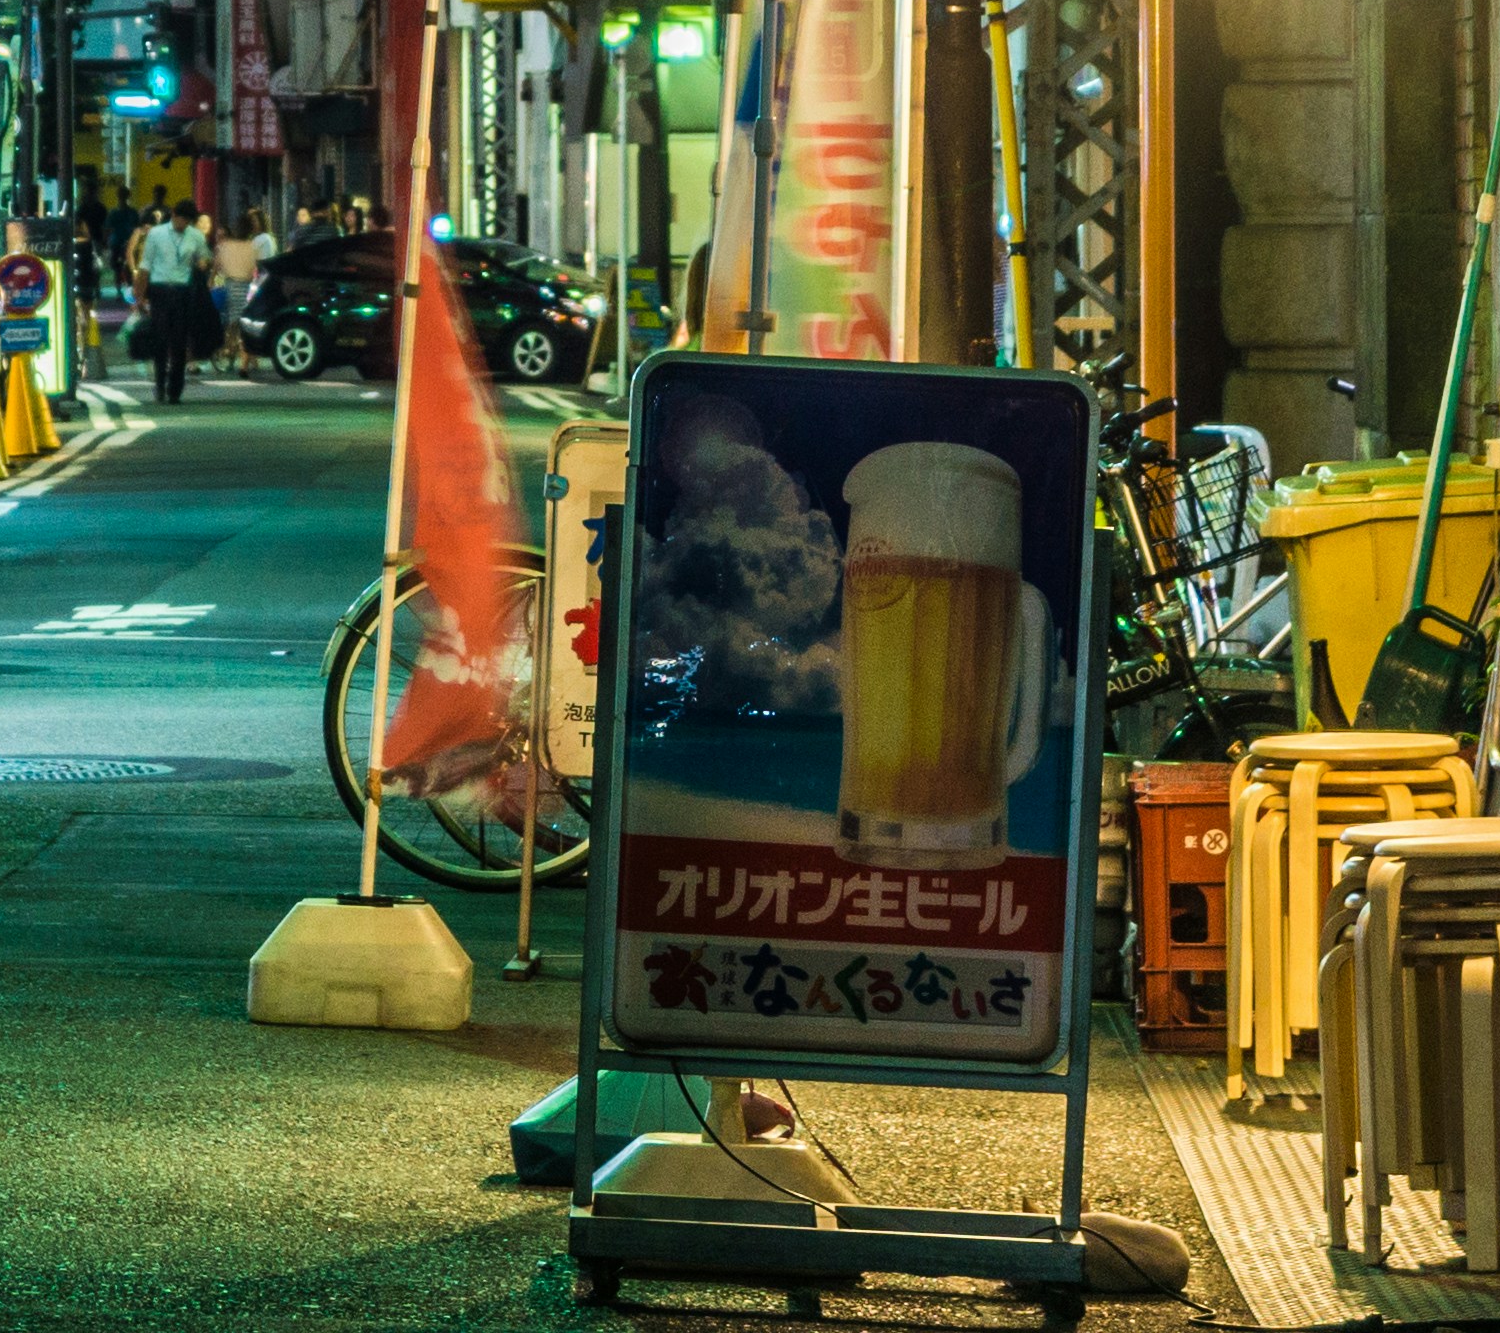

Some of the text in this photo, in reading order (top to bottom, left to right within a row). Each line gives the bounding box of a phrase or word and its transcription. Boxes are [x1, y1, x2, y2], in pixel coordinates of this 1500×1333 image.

[655, 864, 1028, 935] オリオン生ビール
[741, 943, 1032, 1025] なんくるないさ
